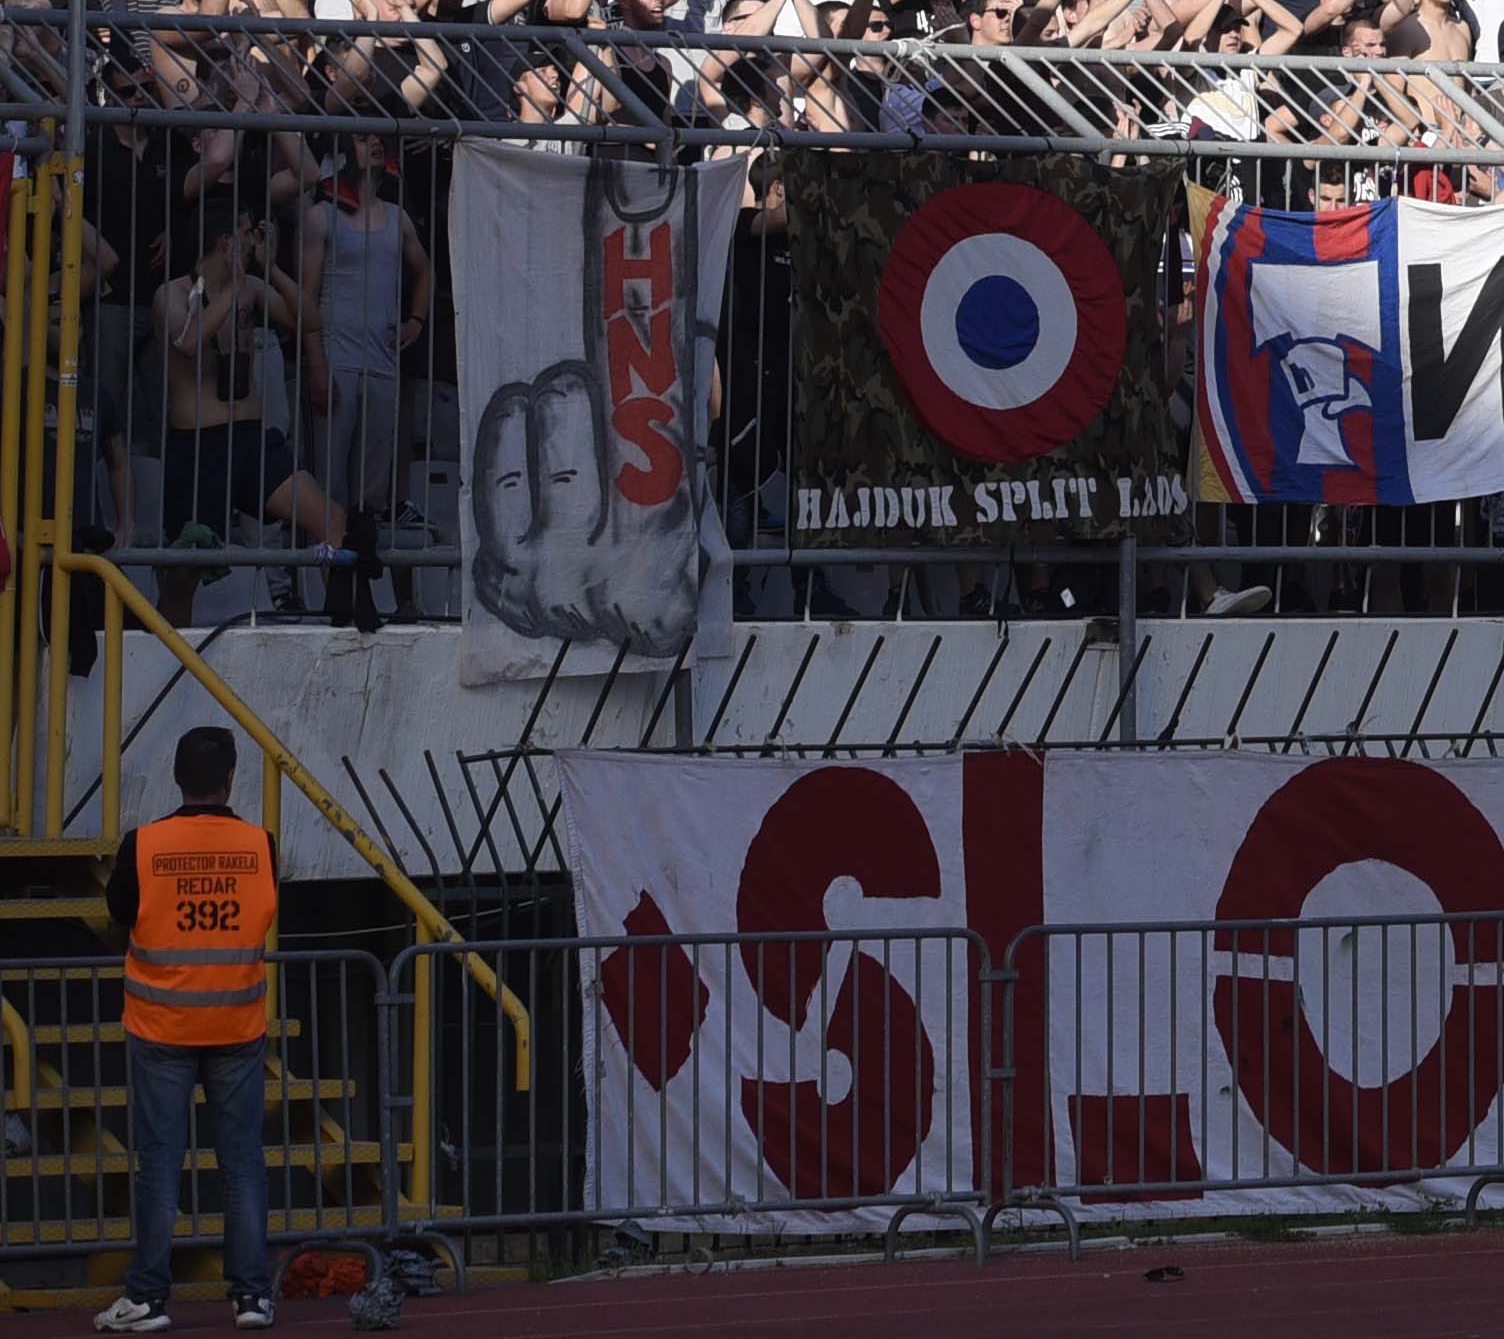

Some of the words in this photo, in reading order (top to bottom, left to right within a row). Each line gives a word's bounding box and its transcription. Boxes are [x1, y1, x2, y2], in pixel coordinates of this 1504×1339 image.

[797, 483, 958, 531] HAJDUK
[155, 855, 216, 873] PROTECTOR
[218, 854, 256, 871] RAKELA
[176, 876, 238, 896] REDAR
[176, 899, 241, 932] 392
